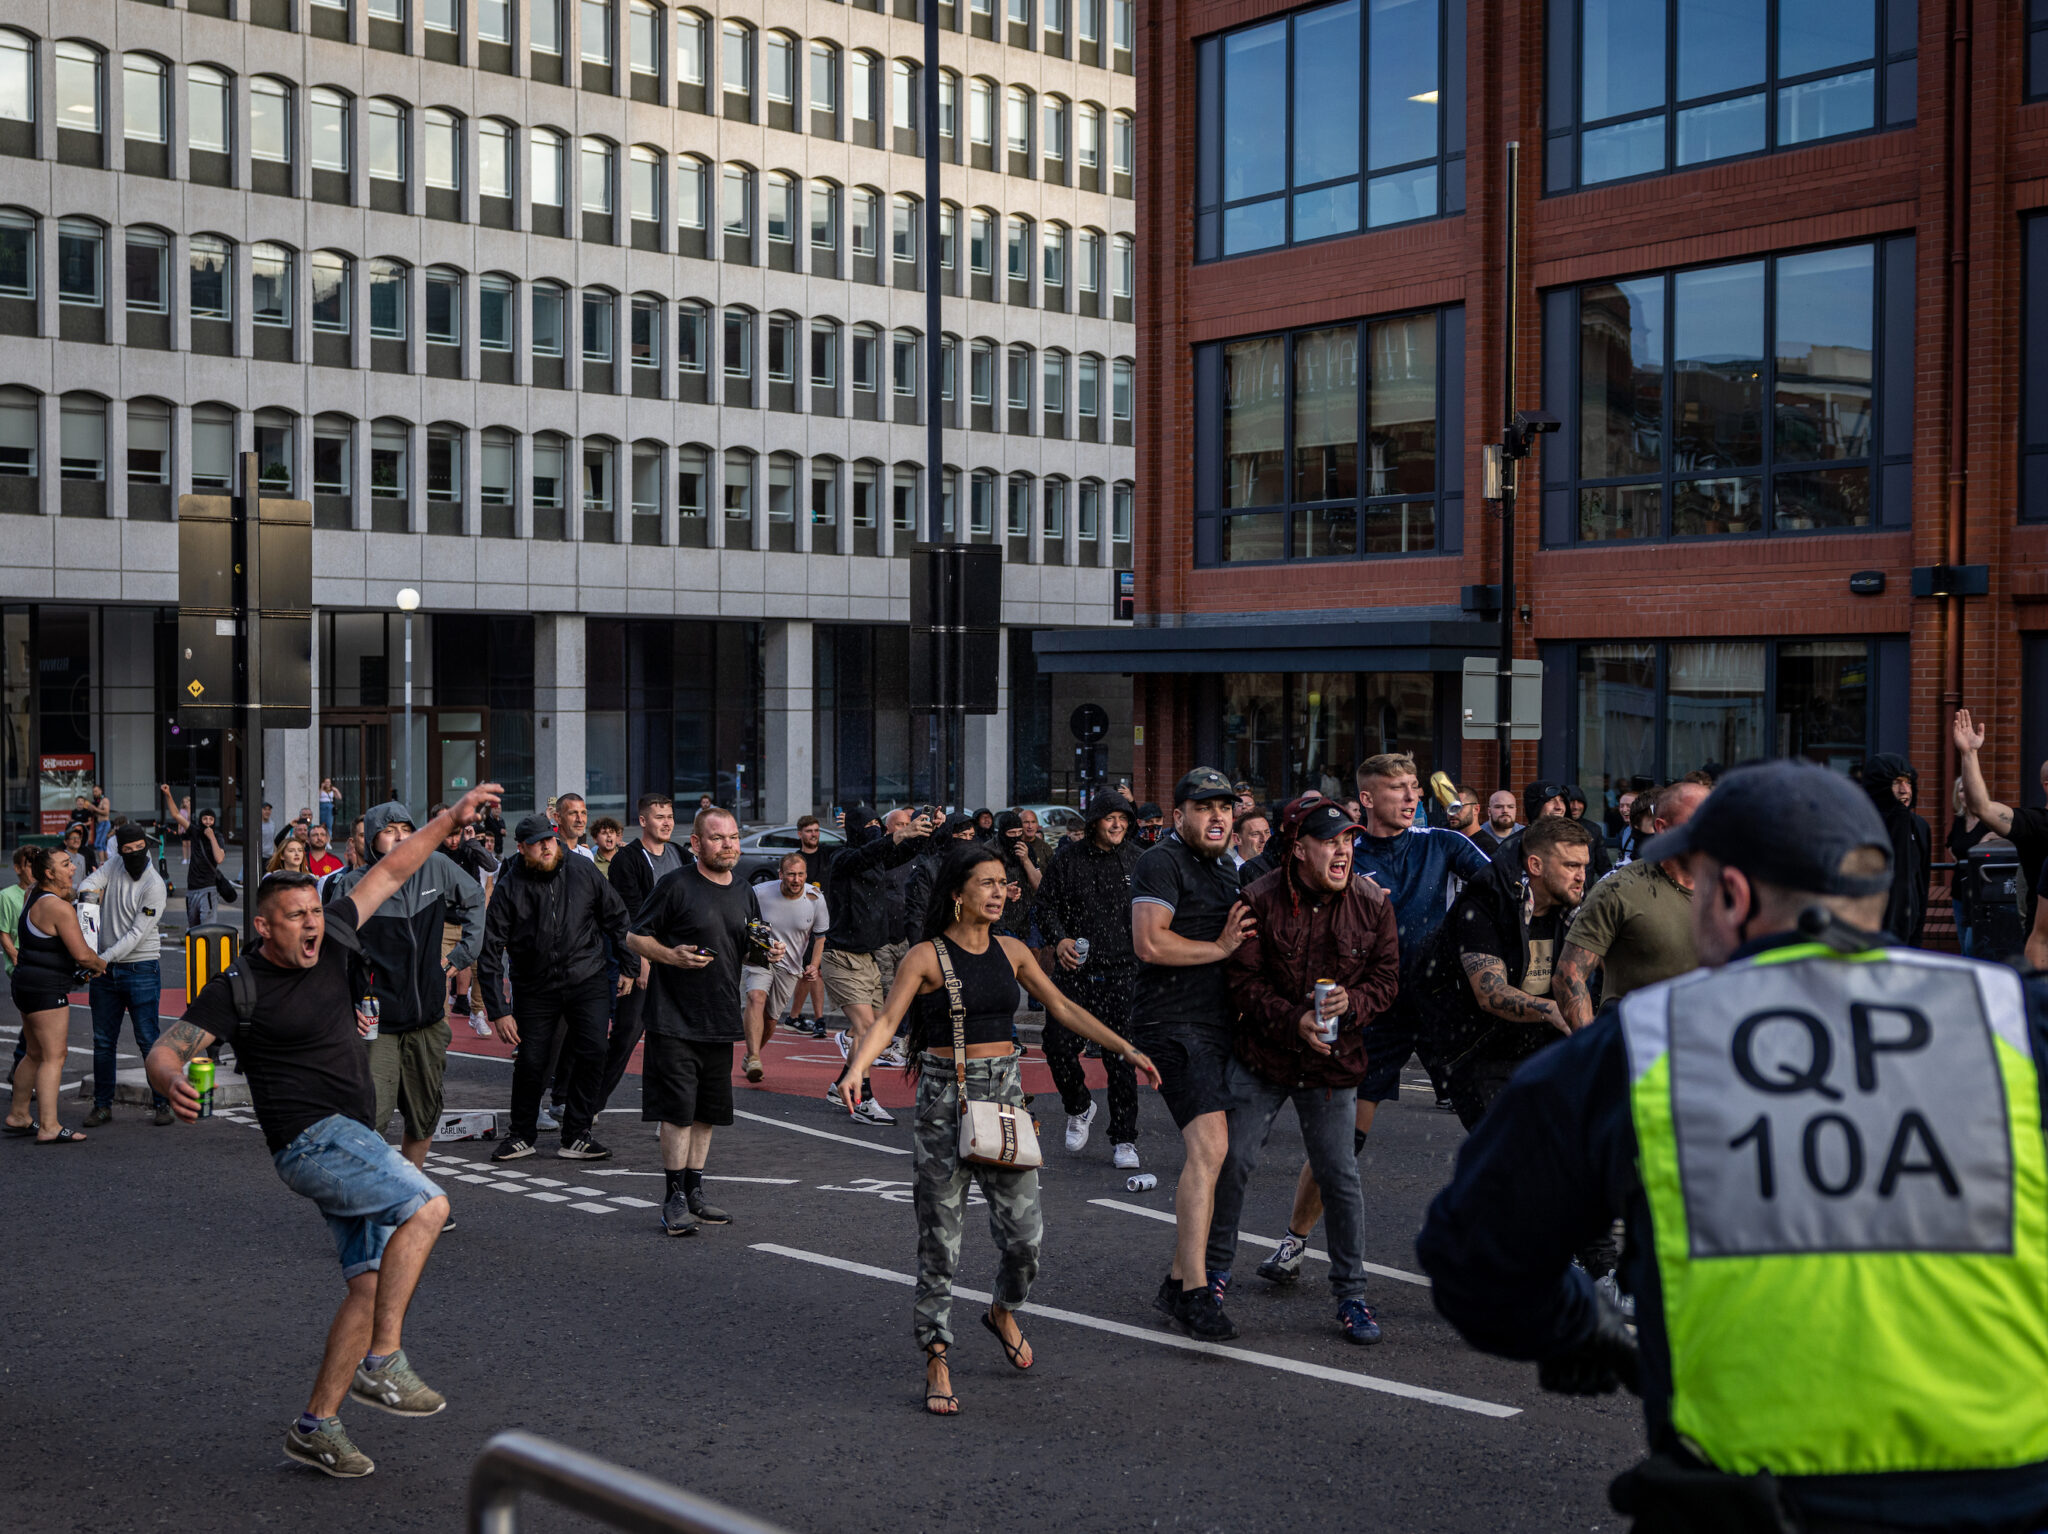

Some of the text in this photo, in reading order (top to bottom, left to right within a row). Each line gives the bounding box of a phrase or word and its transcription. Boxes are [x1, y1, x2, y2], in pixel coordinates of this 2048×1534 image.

[952, 1014, 965, 1049] RIVER
[1731, 1002, 1932, 1102] QP
[440, 1127, 467, 1135] CARLING
[1728, 1111, 1961, 1200] 10A
